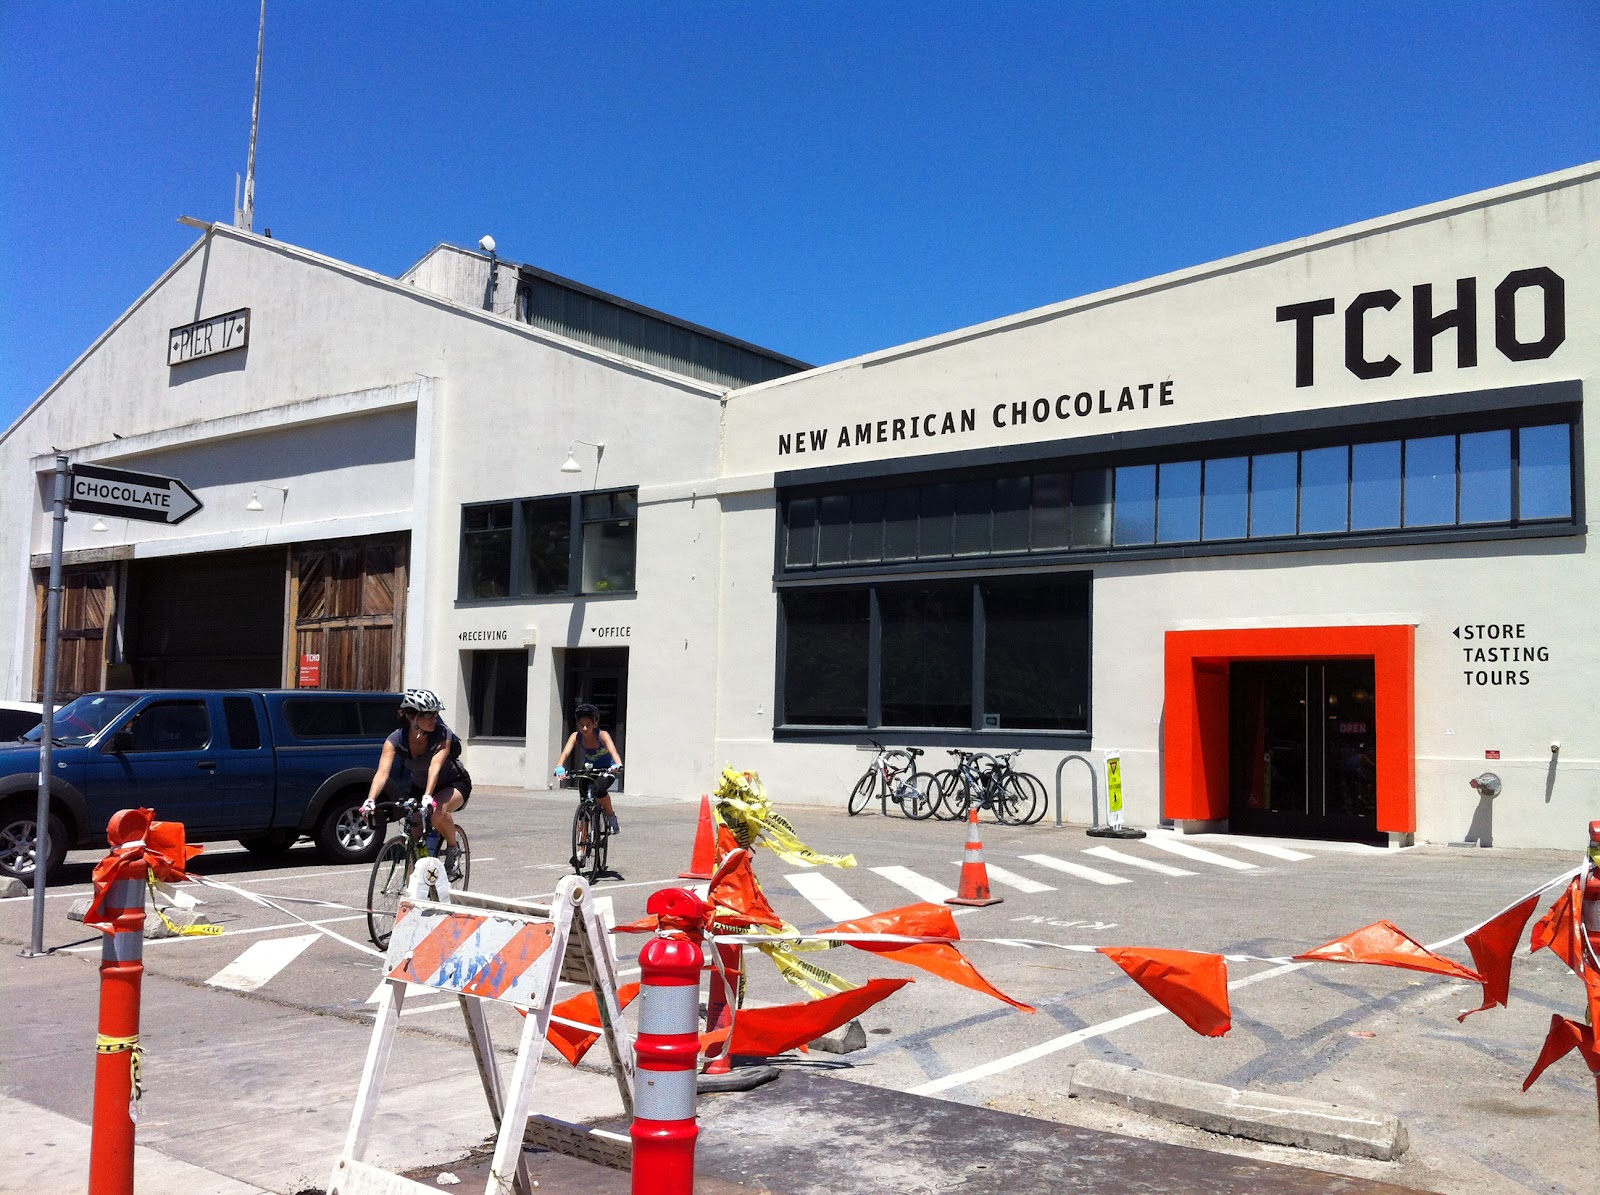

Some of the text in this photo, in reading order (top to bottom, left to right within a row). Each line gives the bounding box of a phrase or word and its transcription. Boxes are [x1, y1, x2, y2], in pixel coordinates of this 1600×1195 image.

[1275, 266, 1566, 388] TCHO
[180, 316, 237, 360] PIER 17
[778, 380, 1175, 456] NEW AMERICAN CHOCOLATE
[76, 481, 171, 507] CHOCOLATE
[462, 630, 508, 642] RECEIVING
[598, 626, 631, 638] OFFICE
[1464, 623, 1526, 640] STORE
[1463, 646, 1549, 662] TASTING
[1463, 670, 1530, 686] TOURS
[1340, 722, 1366, 733] OPEN
